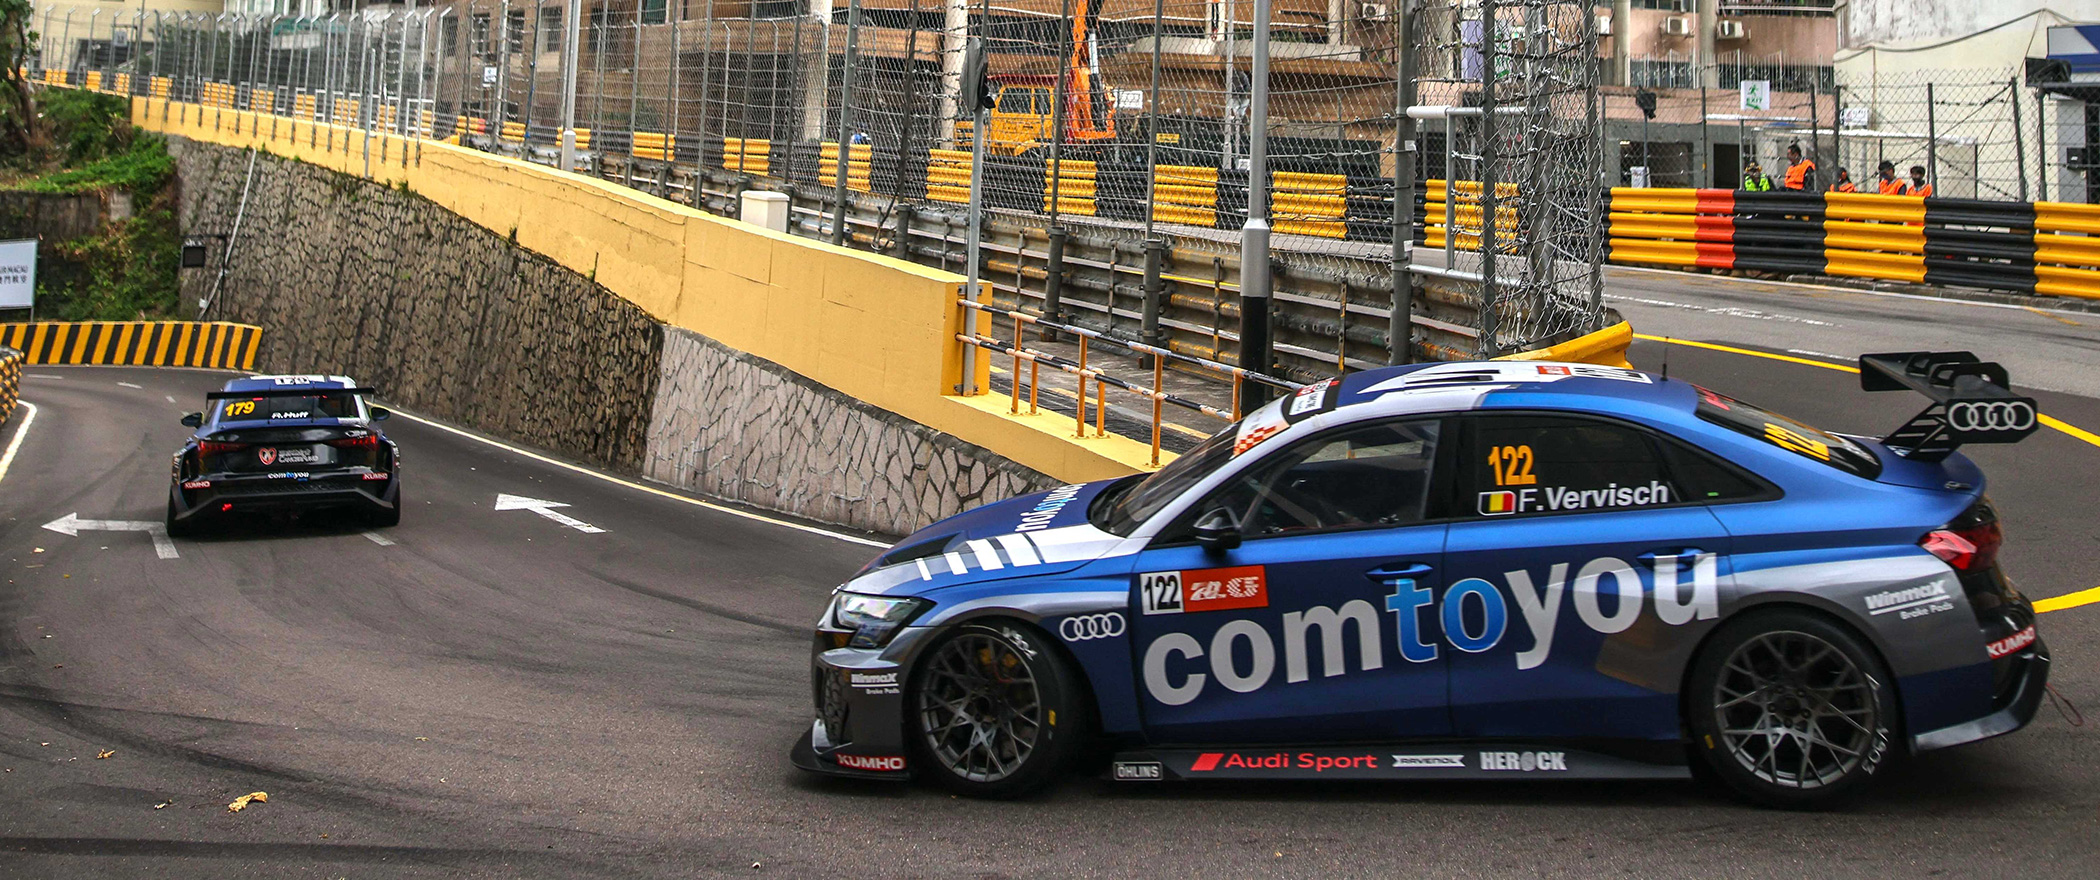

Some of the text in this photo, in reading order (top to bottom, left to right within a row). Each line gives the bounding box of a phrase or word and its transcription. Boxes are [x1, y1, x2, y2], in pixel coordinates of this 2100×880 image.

[225, 401, 255, 416] 179
[267, 471, 310, 479] comtoyou
[1488, 445, 1537, 486] 122
[1518, 480, 1669, 512] F.Vervisch
[1014, 483, 1088, 532] omtoyou
[1144, 574, 1181, 611] 122
[1900, 602, 1954, 620] Brake Pads
[1142, 551, 1720, 706] comtoyou
[1986, 626, 2035, 656] KUMHO
[837, 754, 904, 770] KUMHO
[1116, 763, 1160, 778] ÖHLINS
[1224, 753, 1378, 772] Audi Sport
[1400, 757, 1459, 765] RAVENOL
[1479, 751, 1568, 772] HEROCK
